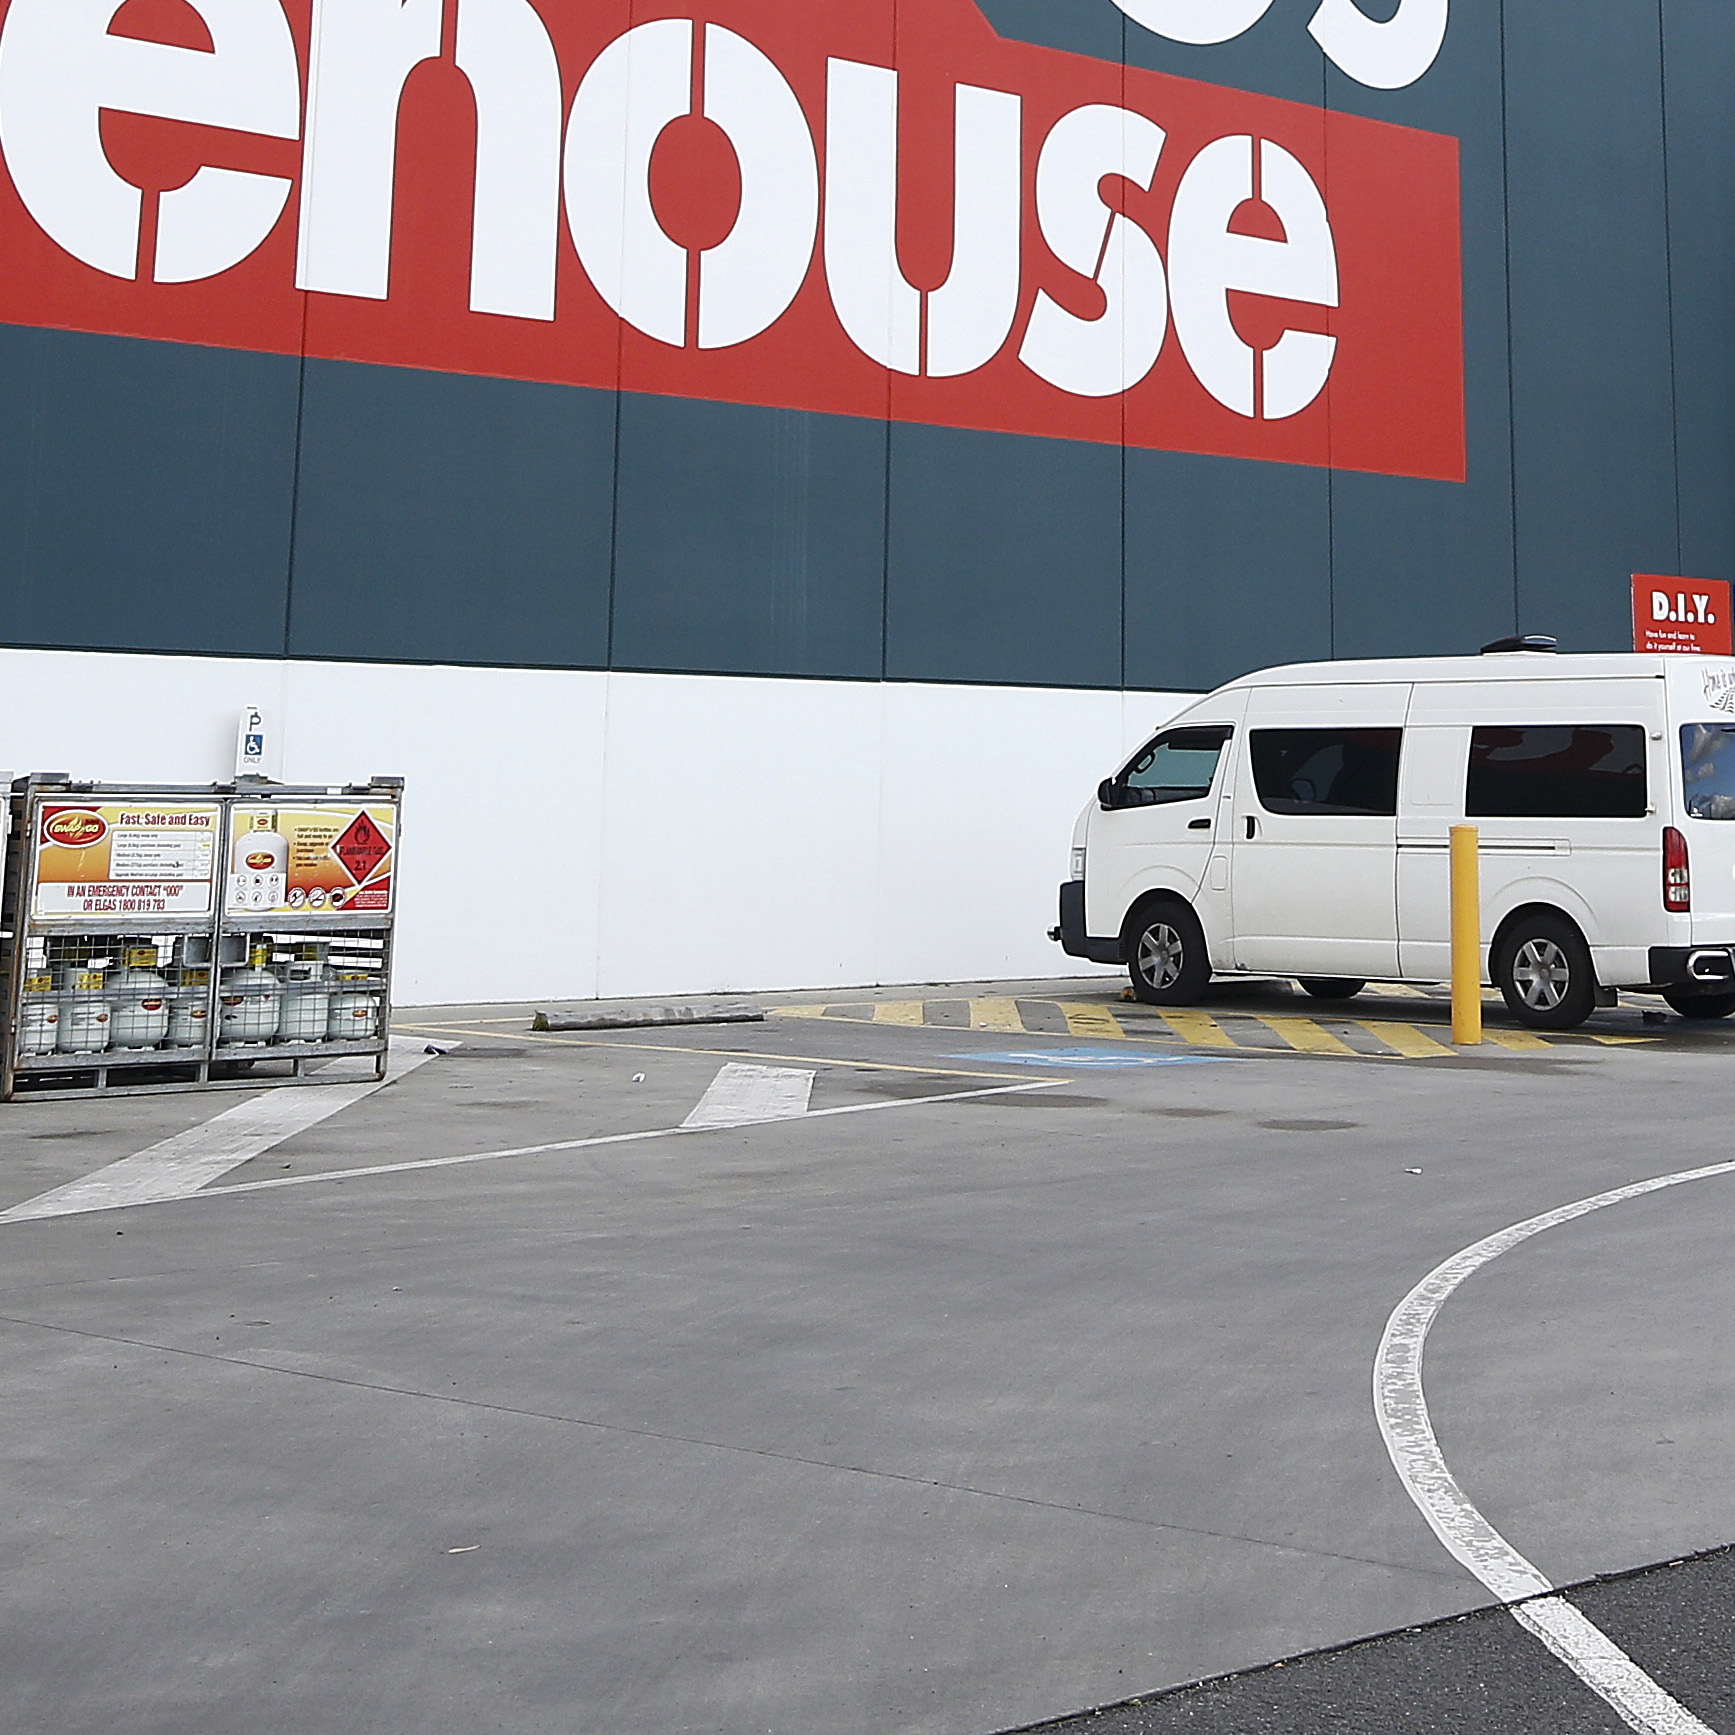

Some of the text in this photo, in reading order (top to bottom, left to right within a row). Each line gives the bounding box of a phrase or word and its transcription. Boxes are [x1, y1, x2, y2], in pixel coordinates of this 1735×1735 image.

[1652, 591, 1716, 625] D.I.Y.
[249, 714, 262, 732] P
[145, 813, 166, 825] Safe
[168, 814, 187, 826] and
[188, 814, 210, 827] Easy
[67, 886, 74, 897] IN
[76, 886, 86, 897] AN
[88, 886, 130, 897] EMERGENCY
[132, 885, 162, 897] CONTACT
[83, 900, 92, 910] OR
[94, 900, 117, 910] ELGAS
[118, 900, 136, 910] 1800
[138, 900, 150, 910] 819
